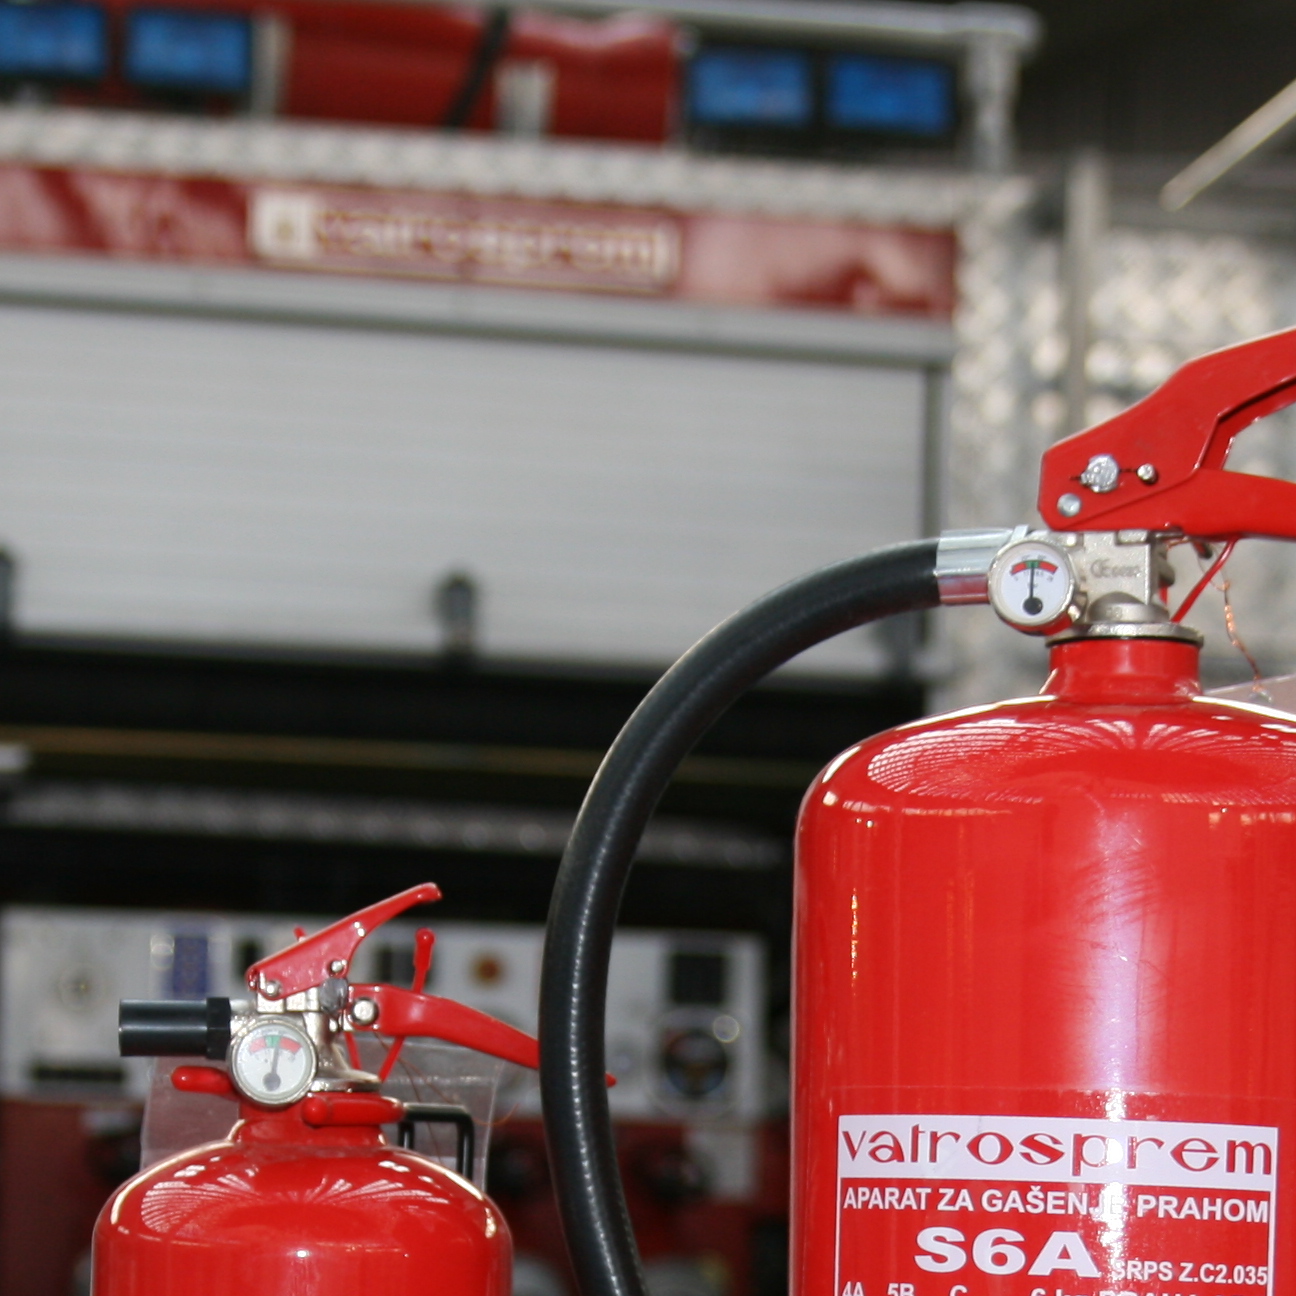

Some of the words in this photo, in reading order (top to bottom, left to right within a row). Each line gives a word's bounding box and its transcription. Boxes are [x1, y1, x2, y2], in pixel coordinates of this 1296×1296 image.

[842, 1124, 1272, 1177] vatrosprem
[844, 1188, 931, 1210] APARAT
[938, 1188, 973, 1212] ZA
[1137, 1194, 1268, 1224] PRAHOM
[914, 1227, 1102, 1278] S6A
[1112, 1260, 1173, 1282] SRPS
[1178, 1263, 1267, 1285] Z.C2.035
